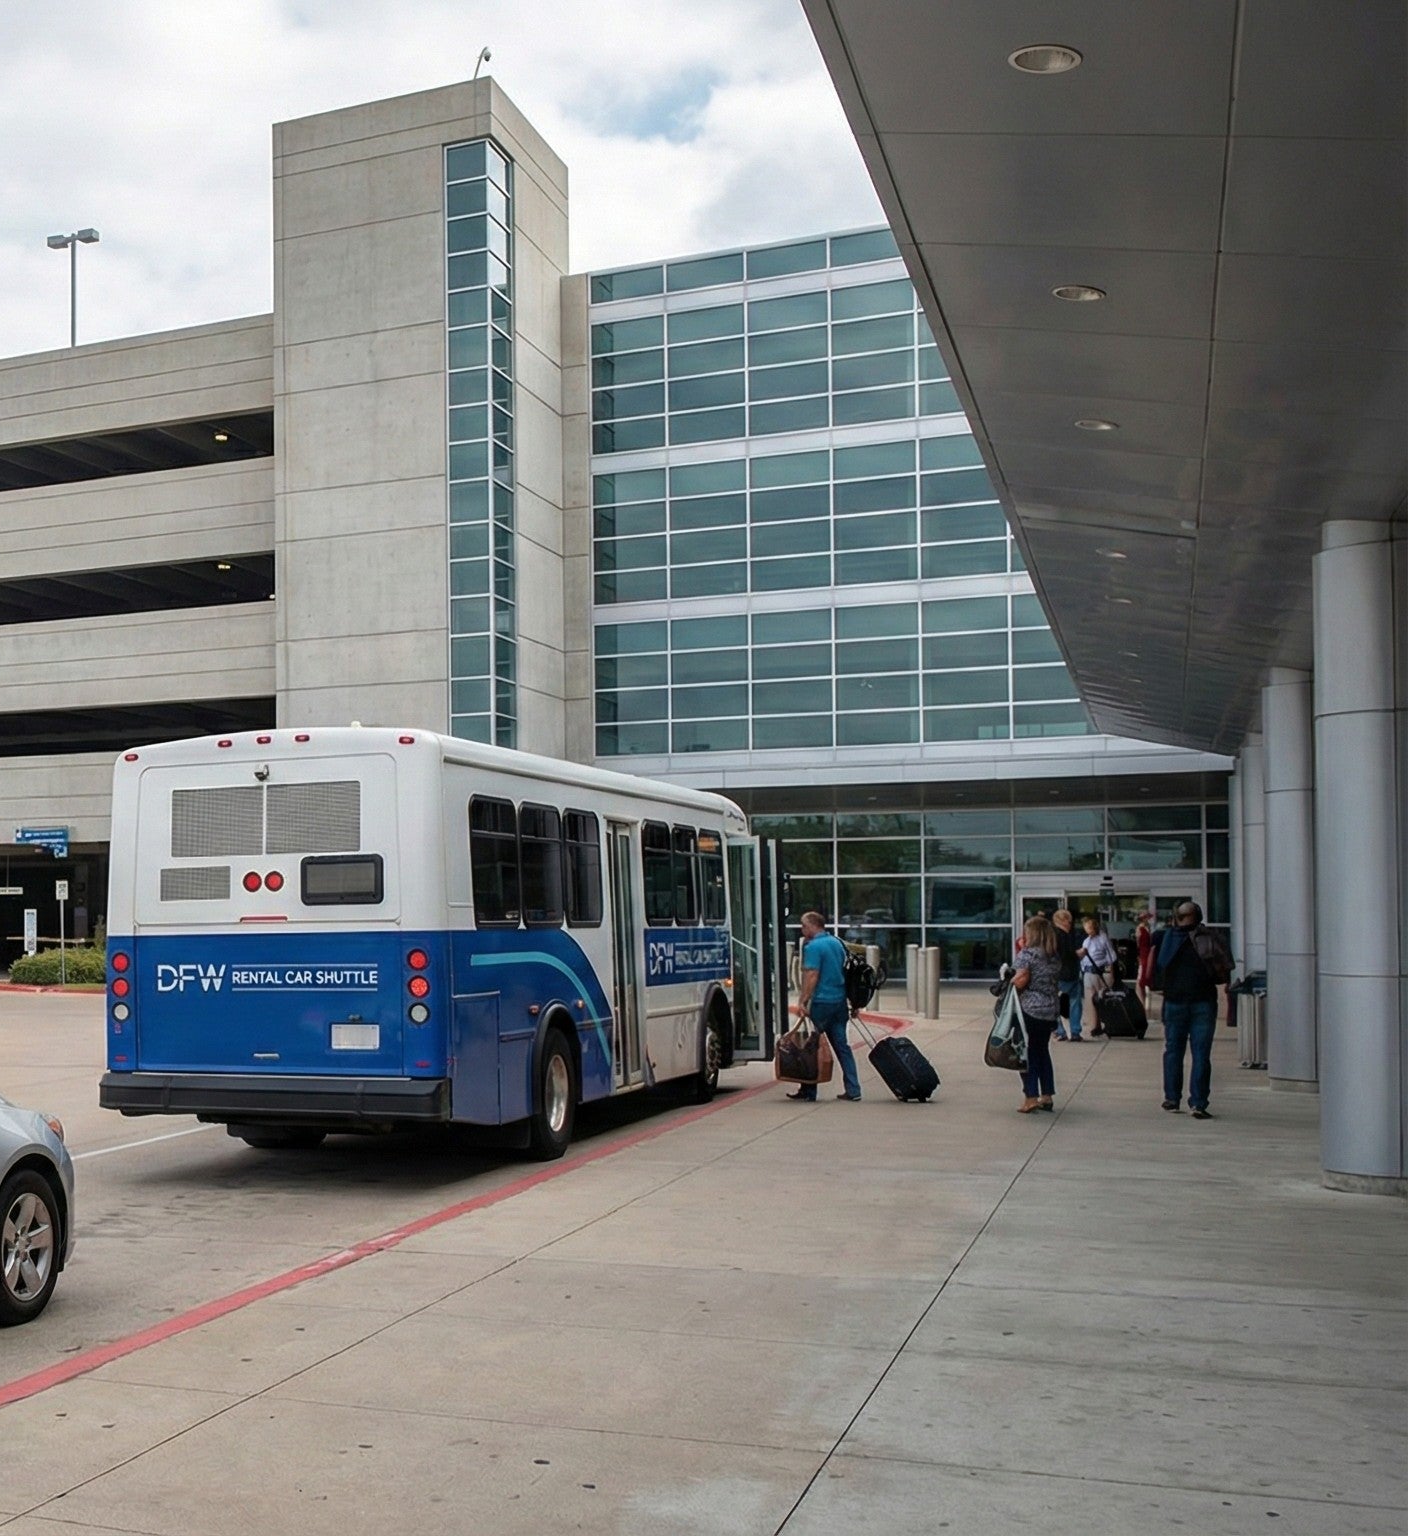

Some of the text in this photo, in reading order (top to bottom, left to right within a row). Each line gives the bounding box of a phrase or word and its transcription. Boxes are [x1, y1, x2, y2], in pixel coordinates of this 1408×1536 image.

[157, 964, 378, 992] DFW RENTAL CAR SHUTTLE
